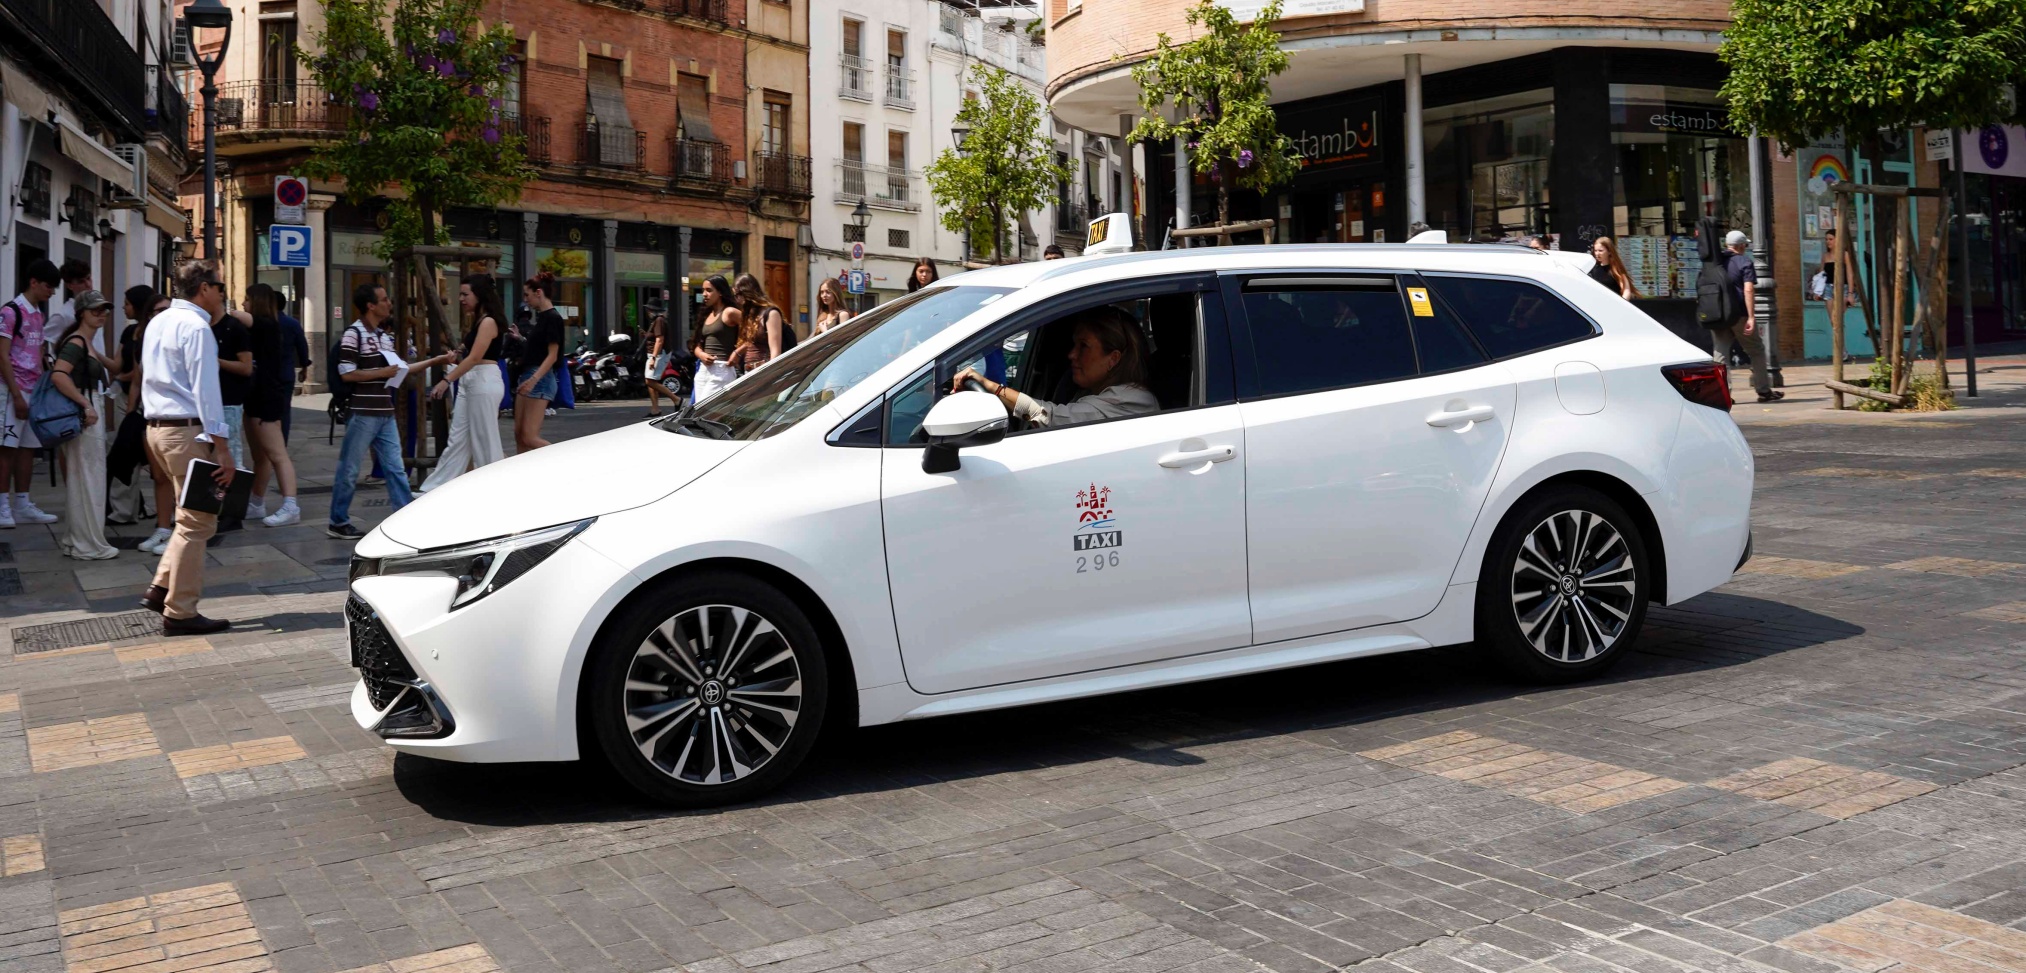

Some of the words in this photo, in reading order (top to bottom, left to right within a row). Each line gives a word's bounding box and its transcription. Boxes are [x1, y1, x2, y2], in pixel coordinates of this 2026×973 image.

[1281, 110, 1378, 160] estambul
[1089, 220, 1105, 245] TAXI
[279, 229, 306, 261] P
[852, 272, 863, 291] P
[367, 336, 378, 352] S
[1077, 531, 1119, 550] TAXI
[1076, 550, 1120, 574] 296
